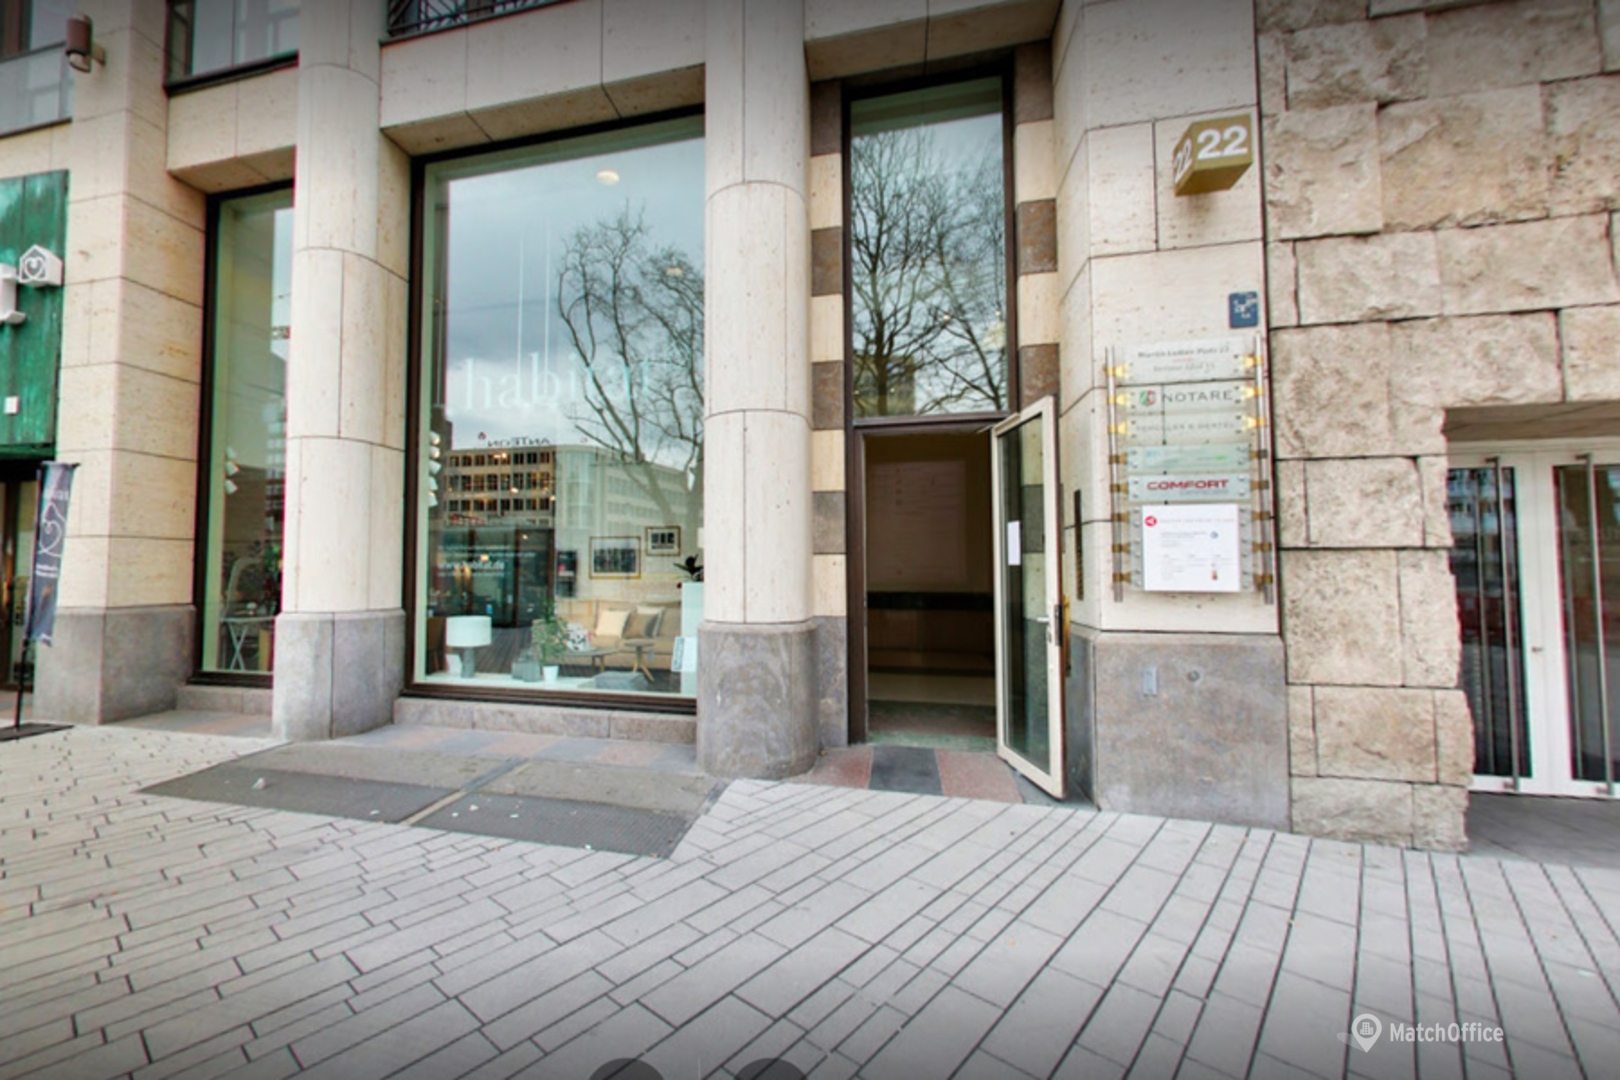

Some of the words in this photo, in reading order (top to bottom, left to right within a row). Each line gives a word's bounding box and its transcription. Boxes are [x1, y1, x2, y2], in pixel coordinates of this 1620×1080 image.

[1197, 125, 1249, 160] 22
[1162, 390, 1233, 403] NOTARE
[1147, 479, 1229, 491] COMFORT
